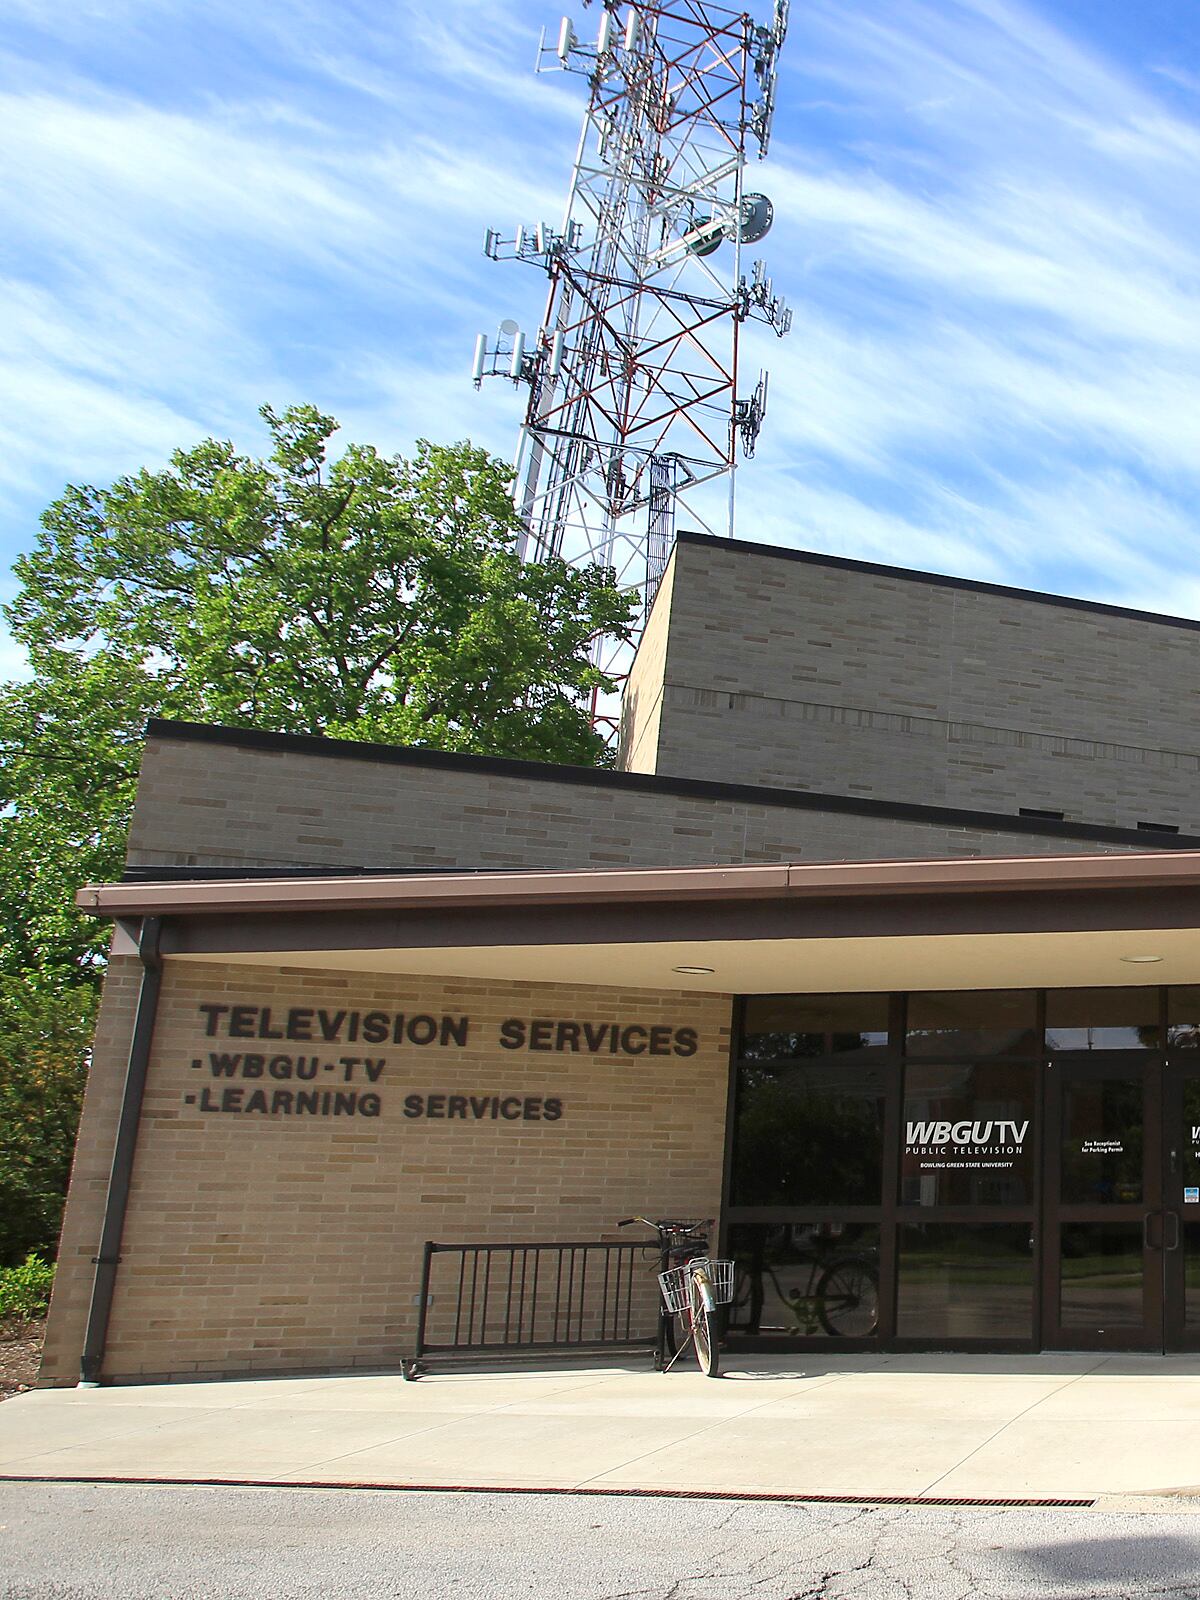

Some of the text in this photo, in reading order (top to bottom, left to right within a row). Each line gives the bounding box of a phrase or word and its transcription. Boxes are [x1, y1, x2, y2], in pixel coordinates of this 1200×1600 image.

[200, 1004, 699, 1057] TELEVISION SERVICES
[200, 1088, 563, 1121] LEARNING SERVICES
[905, 1146, 1023, 1155] PUBLIC TELEVISION
[1089, 1146, 1108, 1154] Parking
